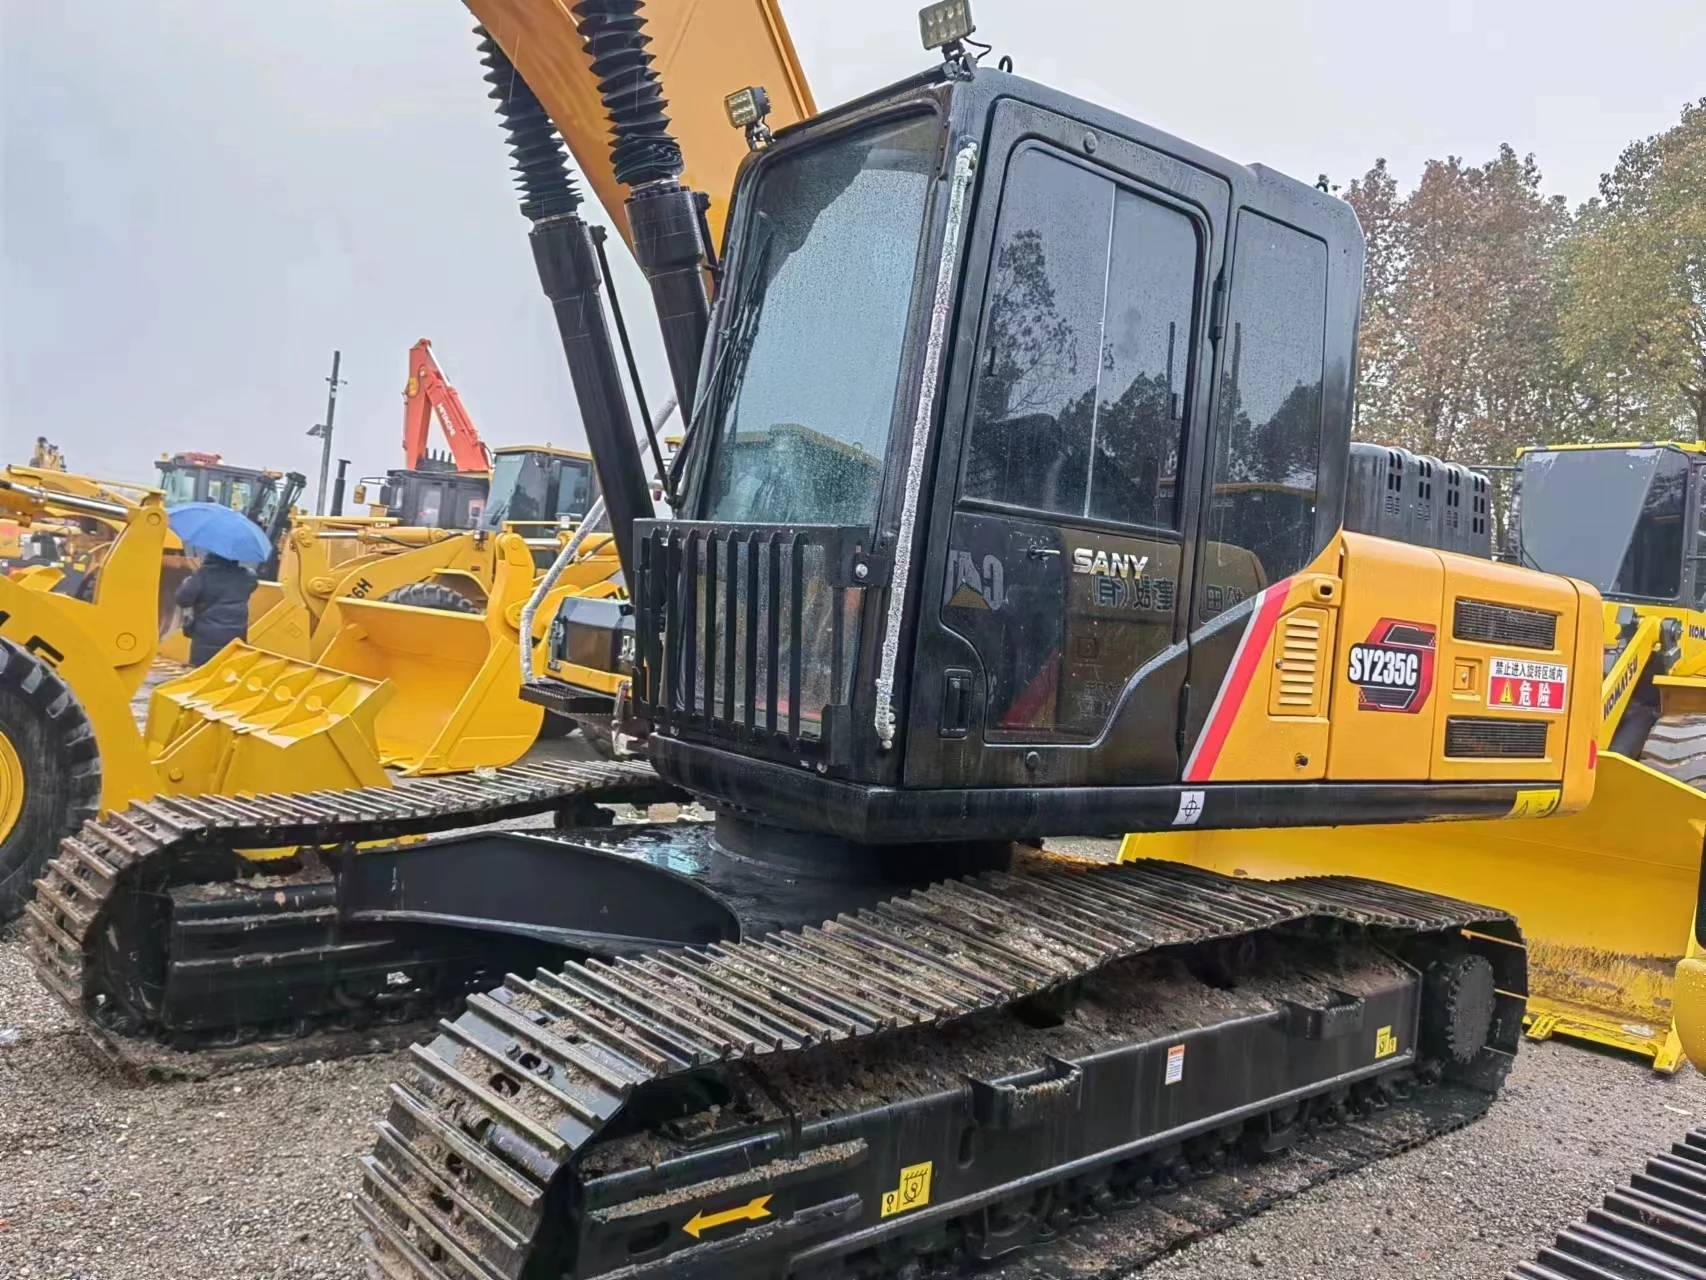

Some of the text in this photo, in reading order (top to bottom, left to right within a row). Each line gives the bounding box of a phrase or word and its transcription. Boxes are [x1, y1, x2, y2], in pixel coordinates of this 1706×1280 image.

[437, 402, 457, 437] HITACHI
[1073, 547, 1149, 580] SANY
[345, 577, 373, 598] 6H
[1689, 623, 1706, 641] KOM
[1349, 647, 1418, 686] SY235C
[1496, 661, 1563, 681] 禁止进入旋转区域内
[1518, 680, 1551, 707] 危险
[1603, 653, 1638, 720] KOMATSU
